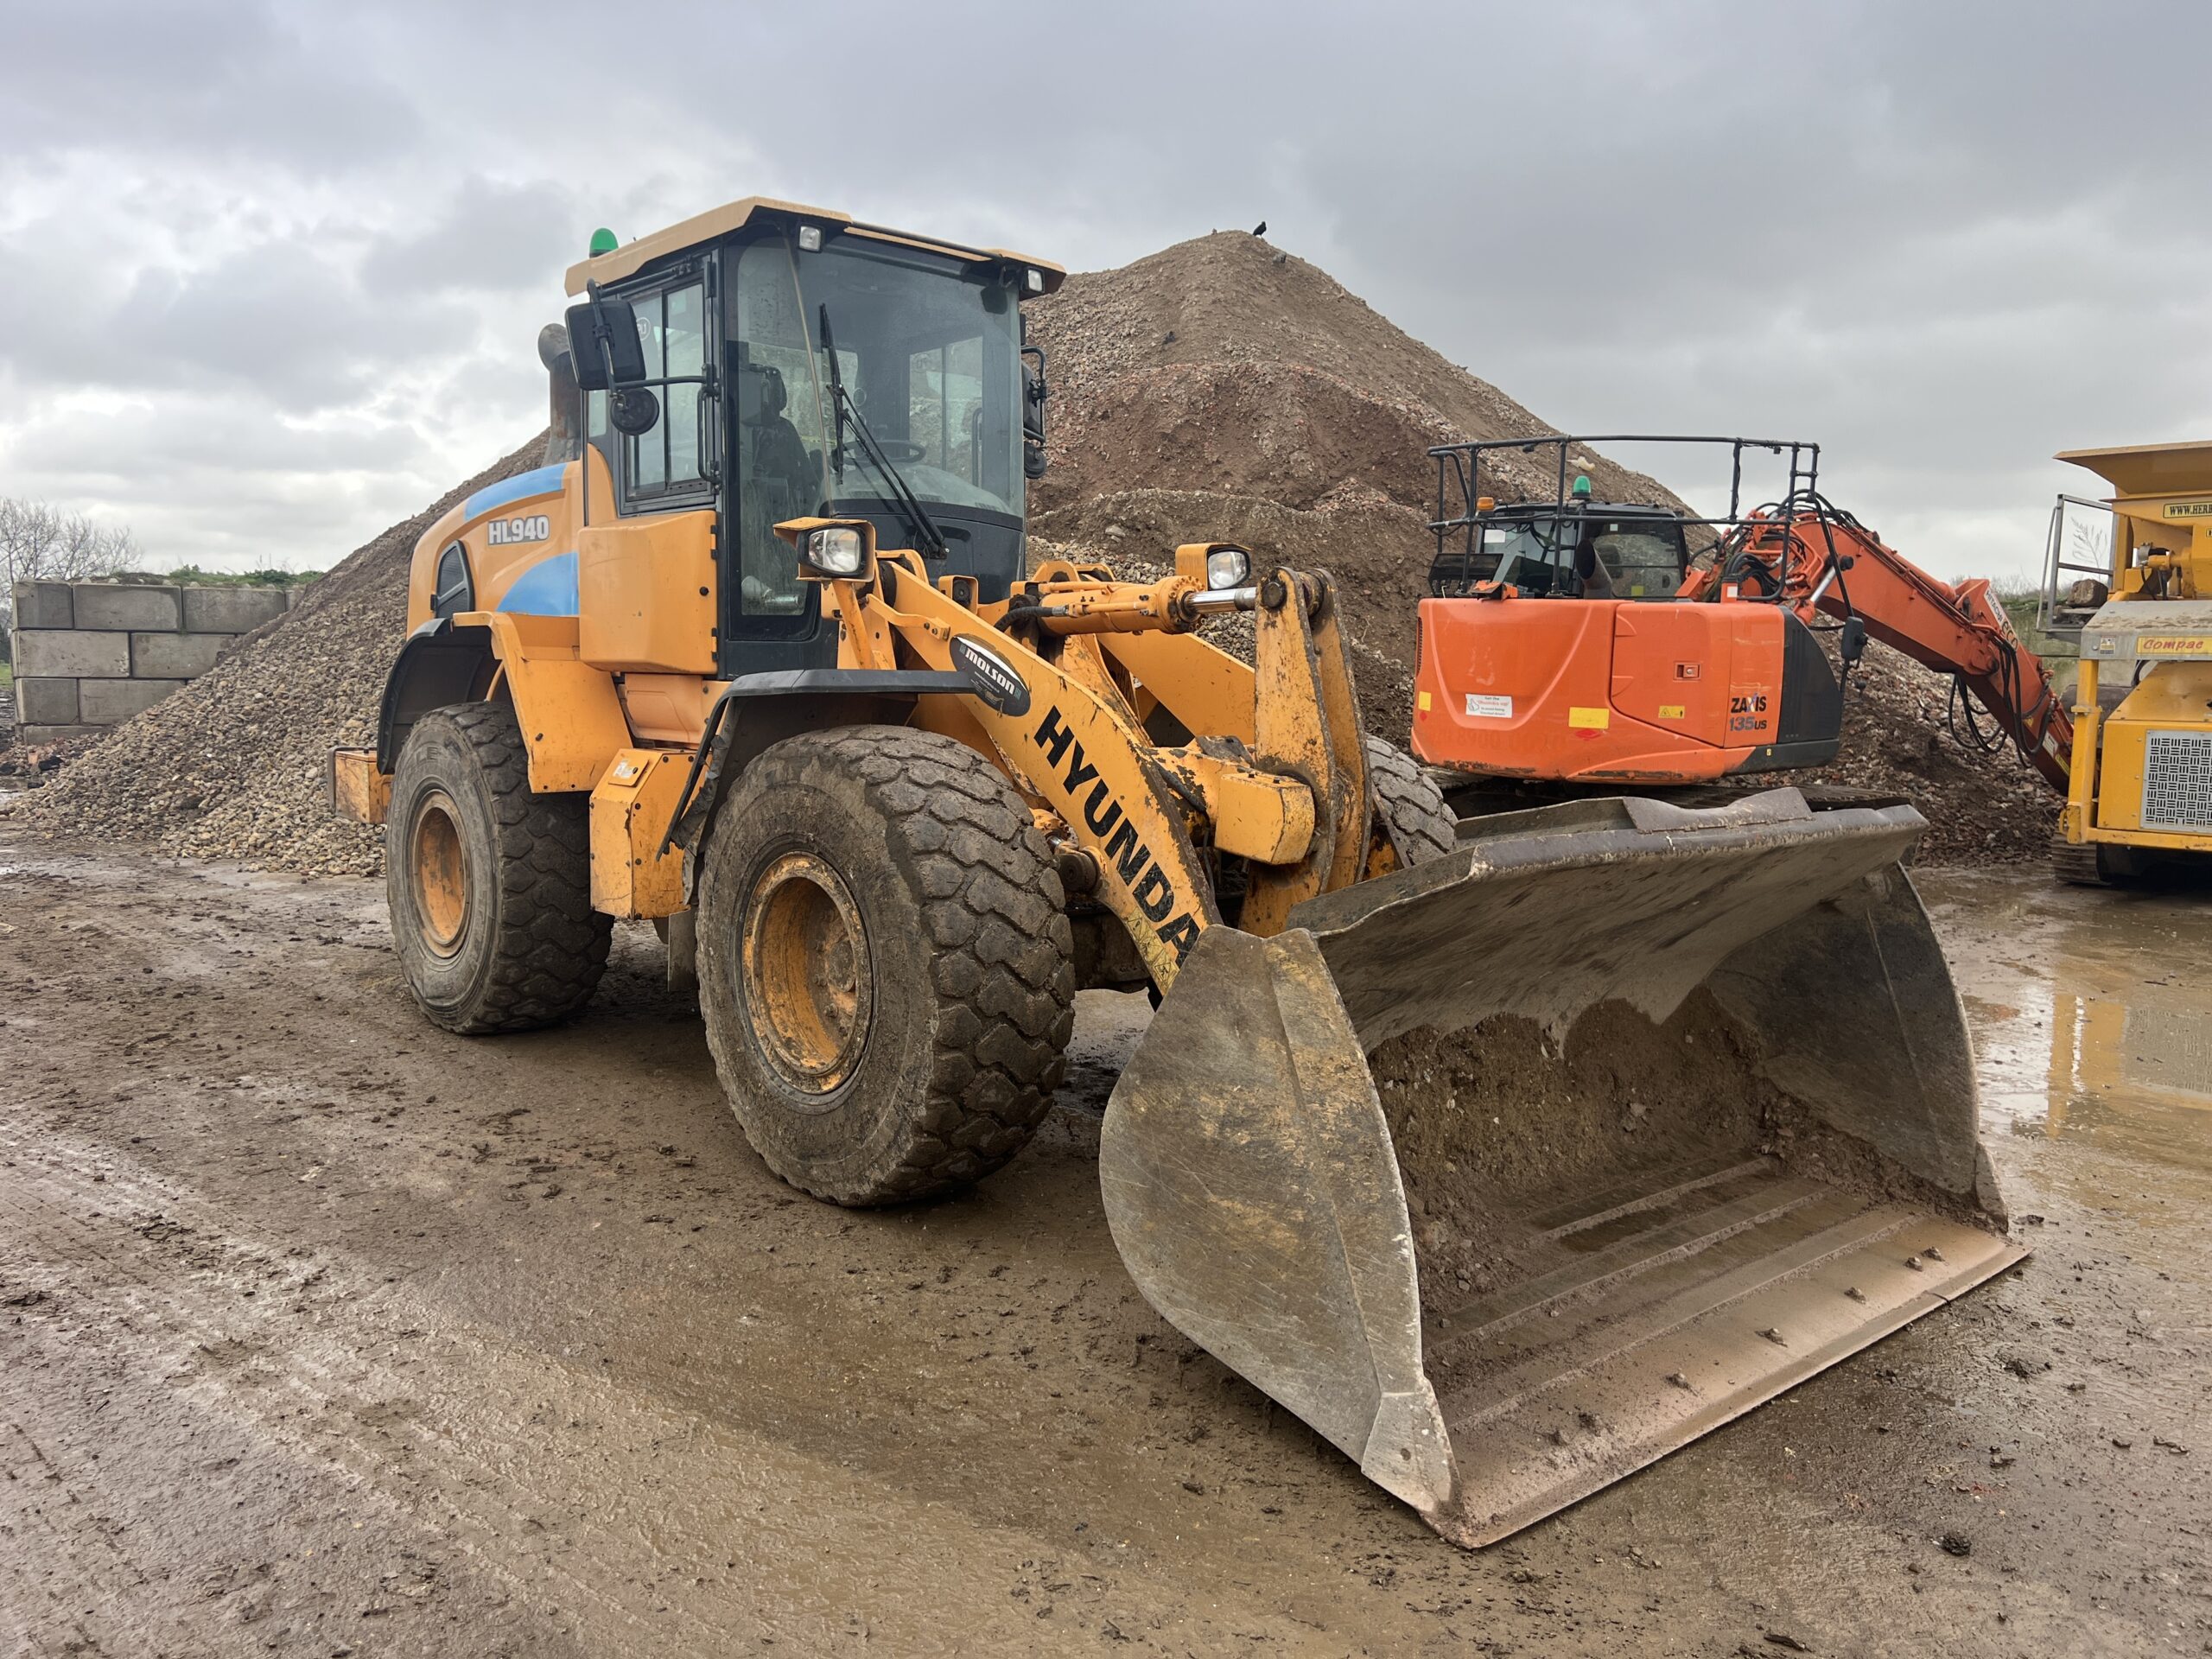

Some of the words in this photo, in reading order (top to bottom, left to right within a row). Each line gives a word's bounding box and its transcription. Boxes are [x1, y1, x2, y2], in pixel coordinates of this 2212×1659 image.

[488, 515, 550, 545] HL940
[2143, 639, 2204, 651] Compac
[964, 647, 1015, 695] MOLSON
[1731, 693, 1767, 713] ZAXIS
[1033, 705, 1201, 969] HYUNDA
